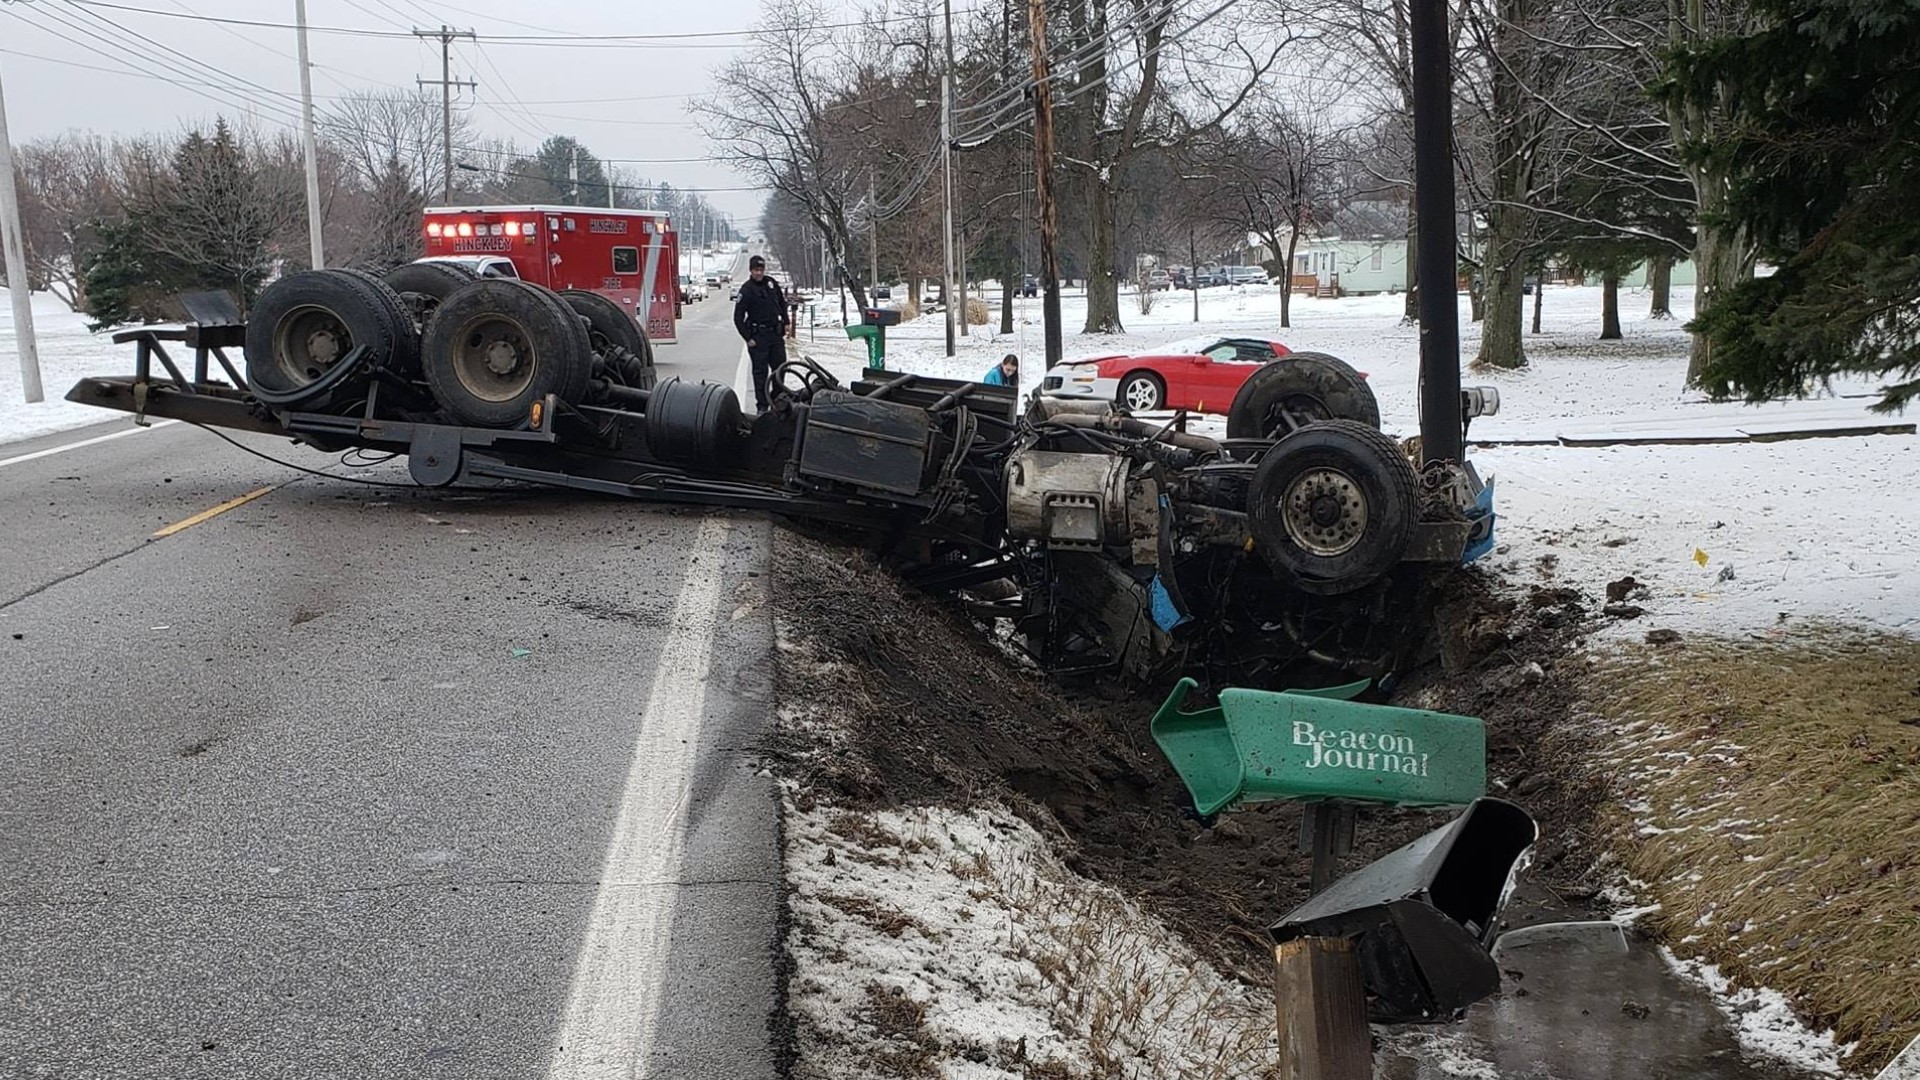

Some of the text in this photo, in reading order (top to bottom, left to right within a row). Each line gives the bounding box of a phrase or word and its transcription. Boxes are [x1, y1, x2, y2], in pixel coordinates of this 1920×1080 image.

[589, 218, 628, 234] HINCKLEY
[453, 237, 513, 252] HINCKLEY
[1293, 720, 1415, 755] Beacon
[1305, 740, 1428, 777] Journal
